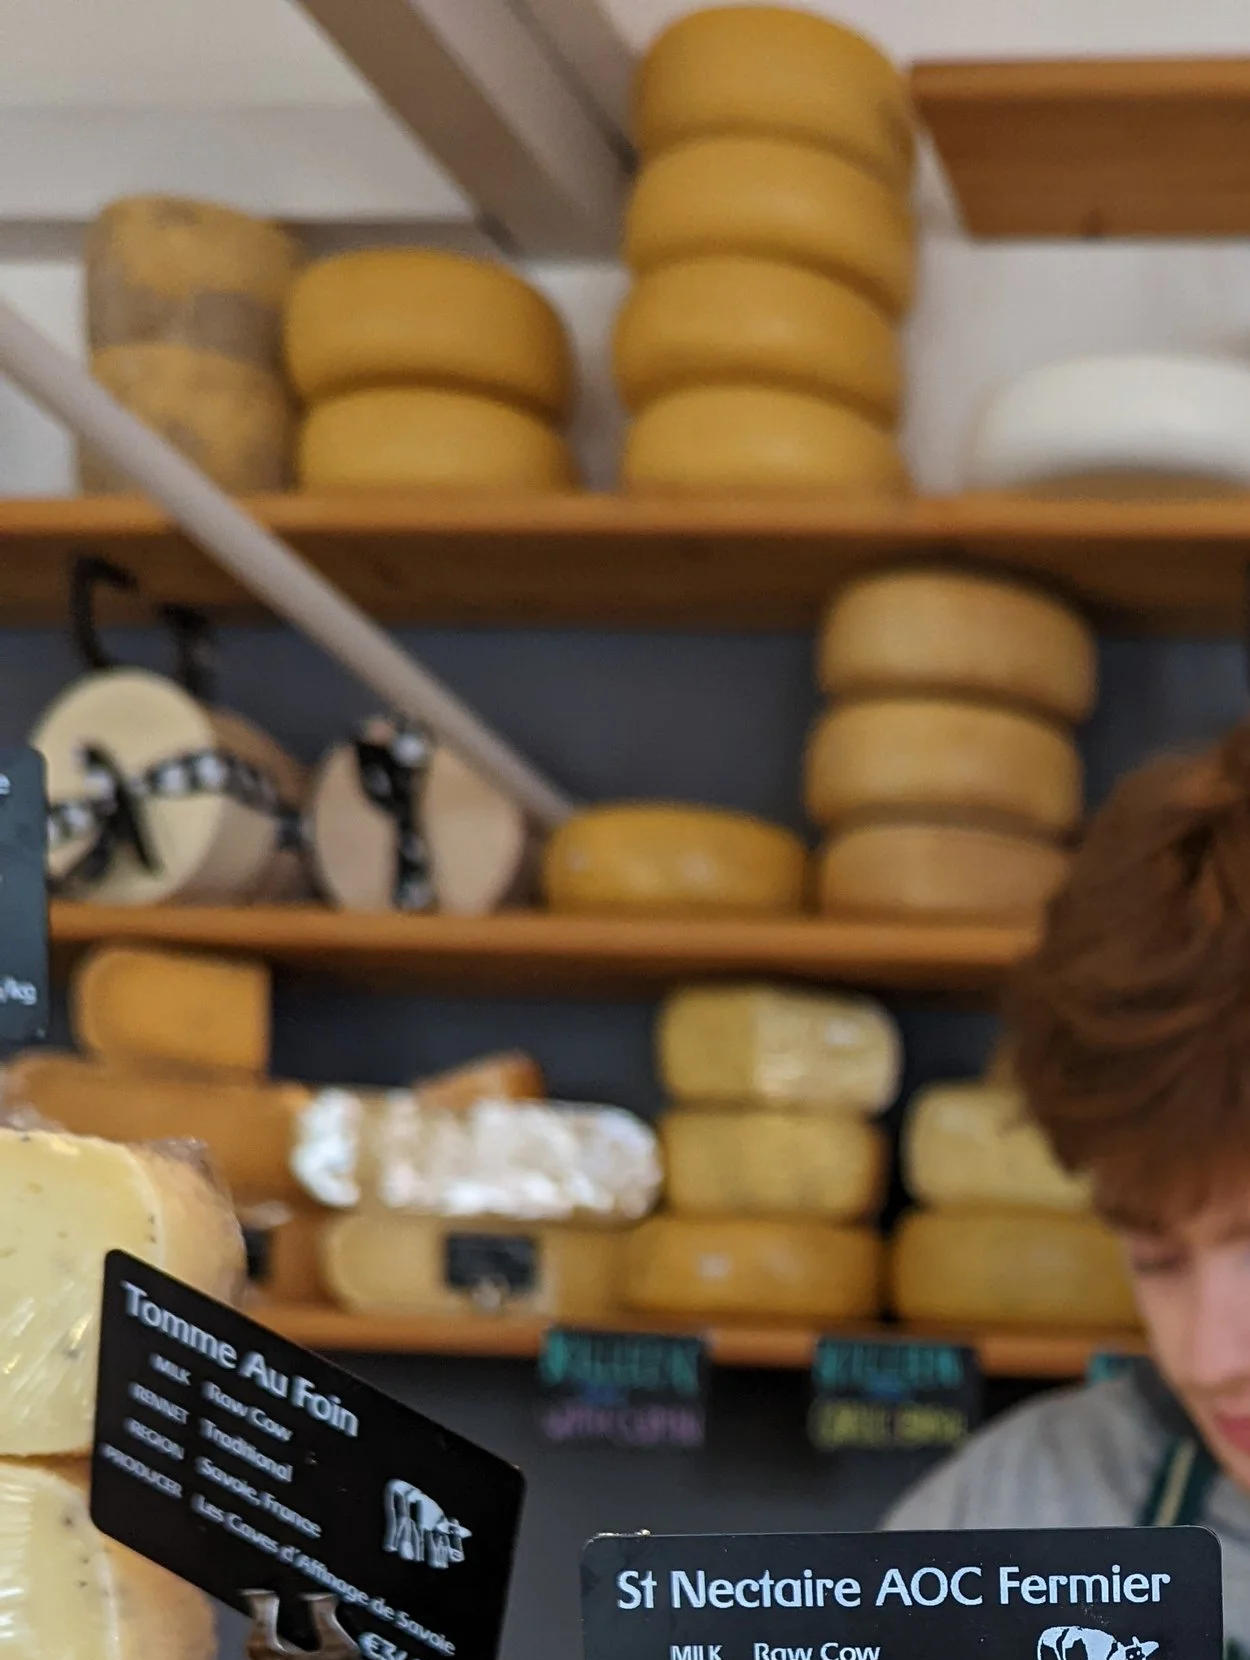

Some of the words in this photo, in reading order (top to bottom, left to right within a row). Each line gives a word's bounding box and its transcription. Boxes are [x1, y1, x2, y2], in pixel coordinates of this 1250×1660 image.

[121, 1280, 238, 1369] Tomme
[238, 1351, 289, 1399] Au
[290, 1374, 359, 1437] Foin
[150, 1353, 192, 1386] MILK
[202, 1381, 248, 1417] Raw
[246, 1406, 293, 1442] Cow
[124, 1417, 184, 1460] REGION
[260, 1492, 322, 1538] France
[128, 1381, 190, 1424] RENNET
[198, 1417, 293, 1483] Traditional
[100, 1443, 183, 1498] PRODUCER
[191, 1494, 224, 1523] Les
[223, 1512, 279, 1553] Caves
[367, 1597, 394, 1621] de
[394, 1610, 456, 1656] Savoie
[617, 1570, 657, 1610] St
[671, 1569, 862, 1609] Nectaire
[875, 1566, 984, 1607] AOC
[1000, 1563, 1171, 1604] Fermier
